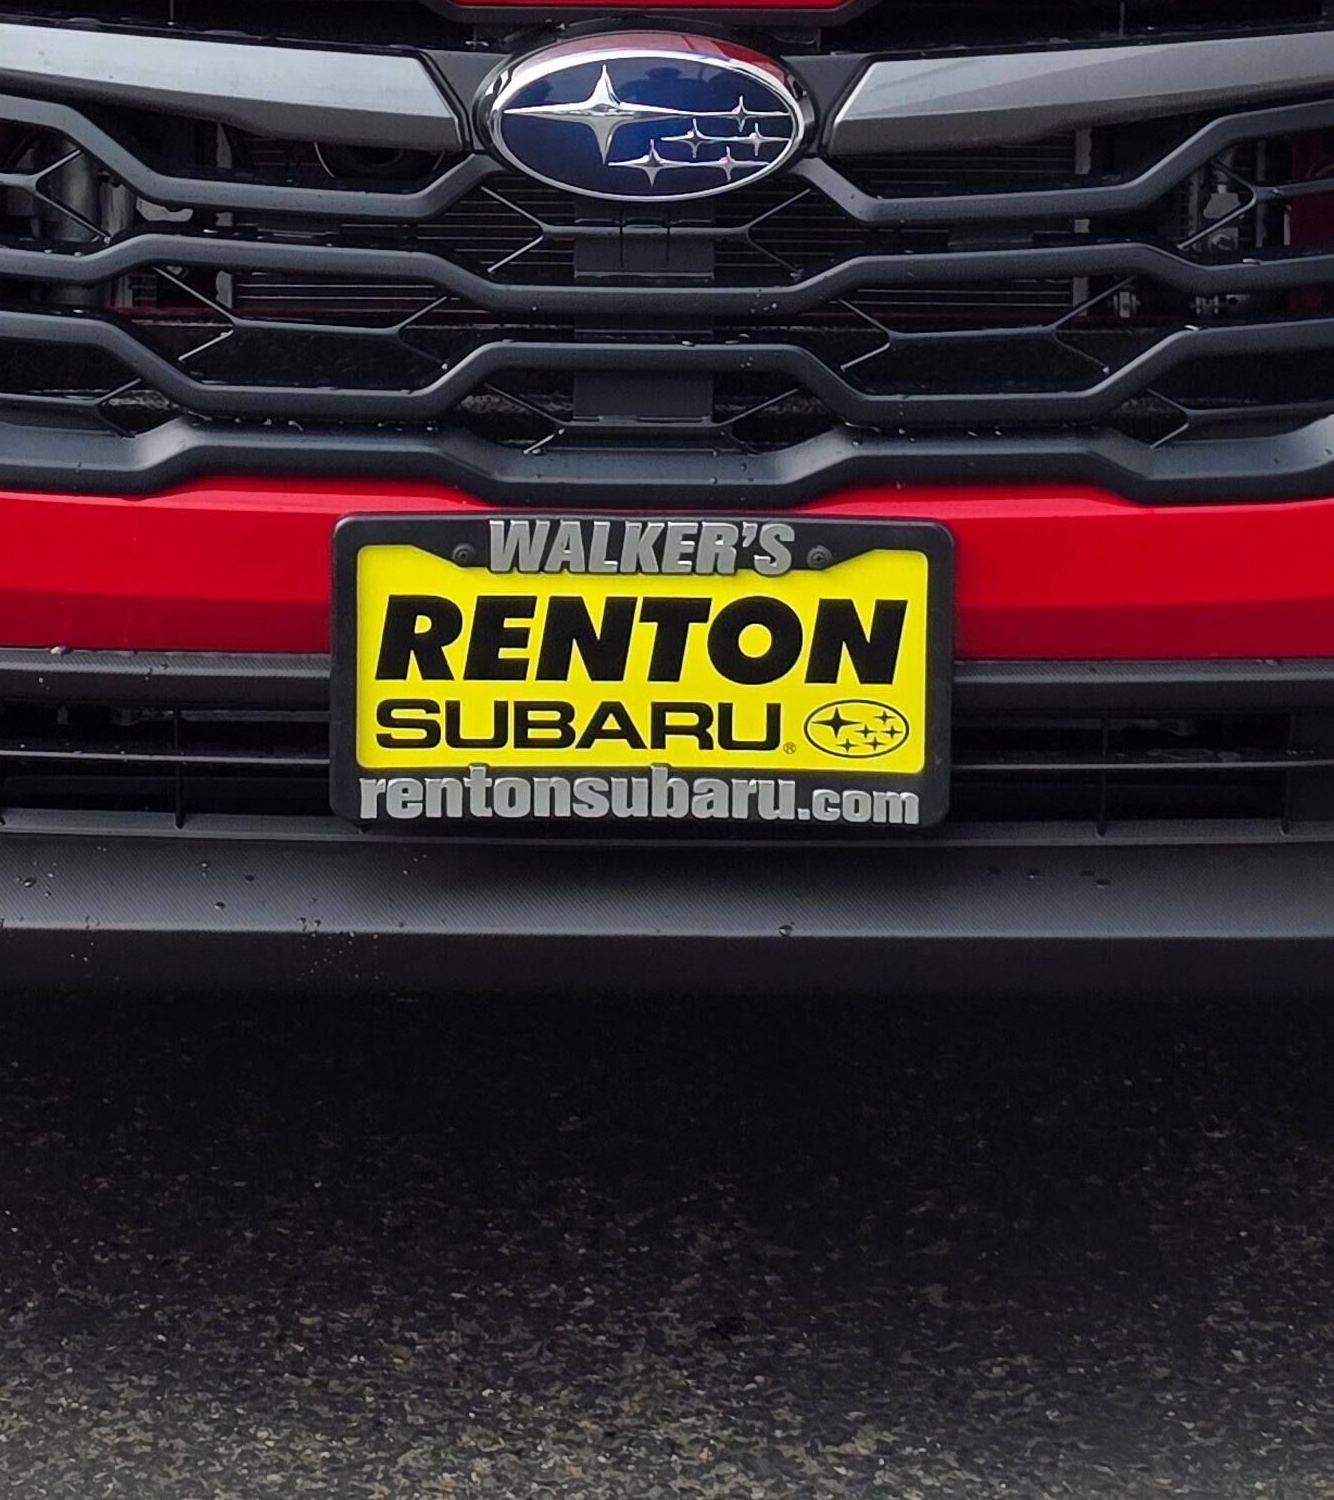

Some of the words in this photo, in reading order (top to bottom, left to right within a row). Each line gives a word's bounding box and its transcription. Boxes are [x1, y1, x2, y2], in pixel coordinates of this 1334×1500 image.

[489, 519, 795, 576] WALKER'S
[375, 594, 908, 685] RENTON
[375, 698, 782, 751] SUBARU
[359, 765, 920, 825] rentonsubaru.com
